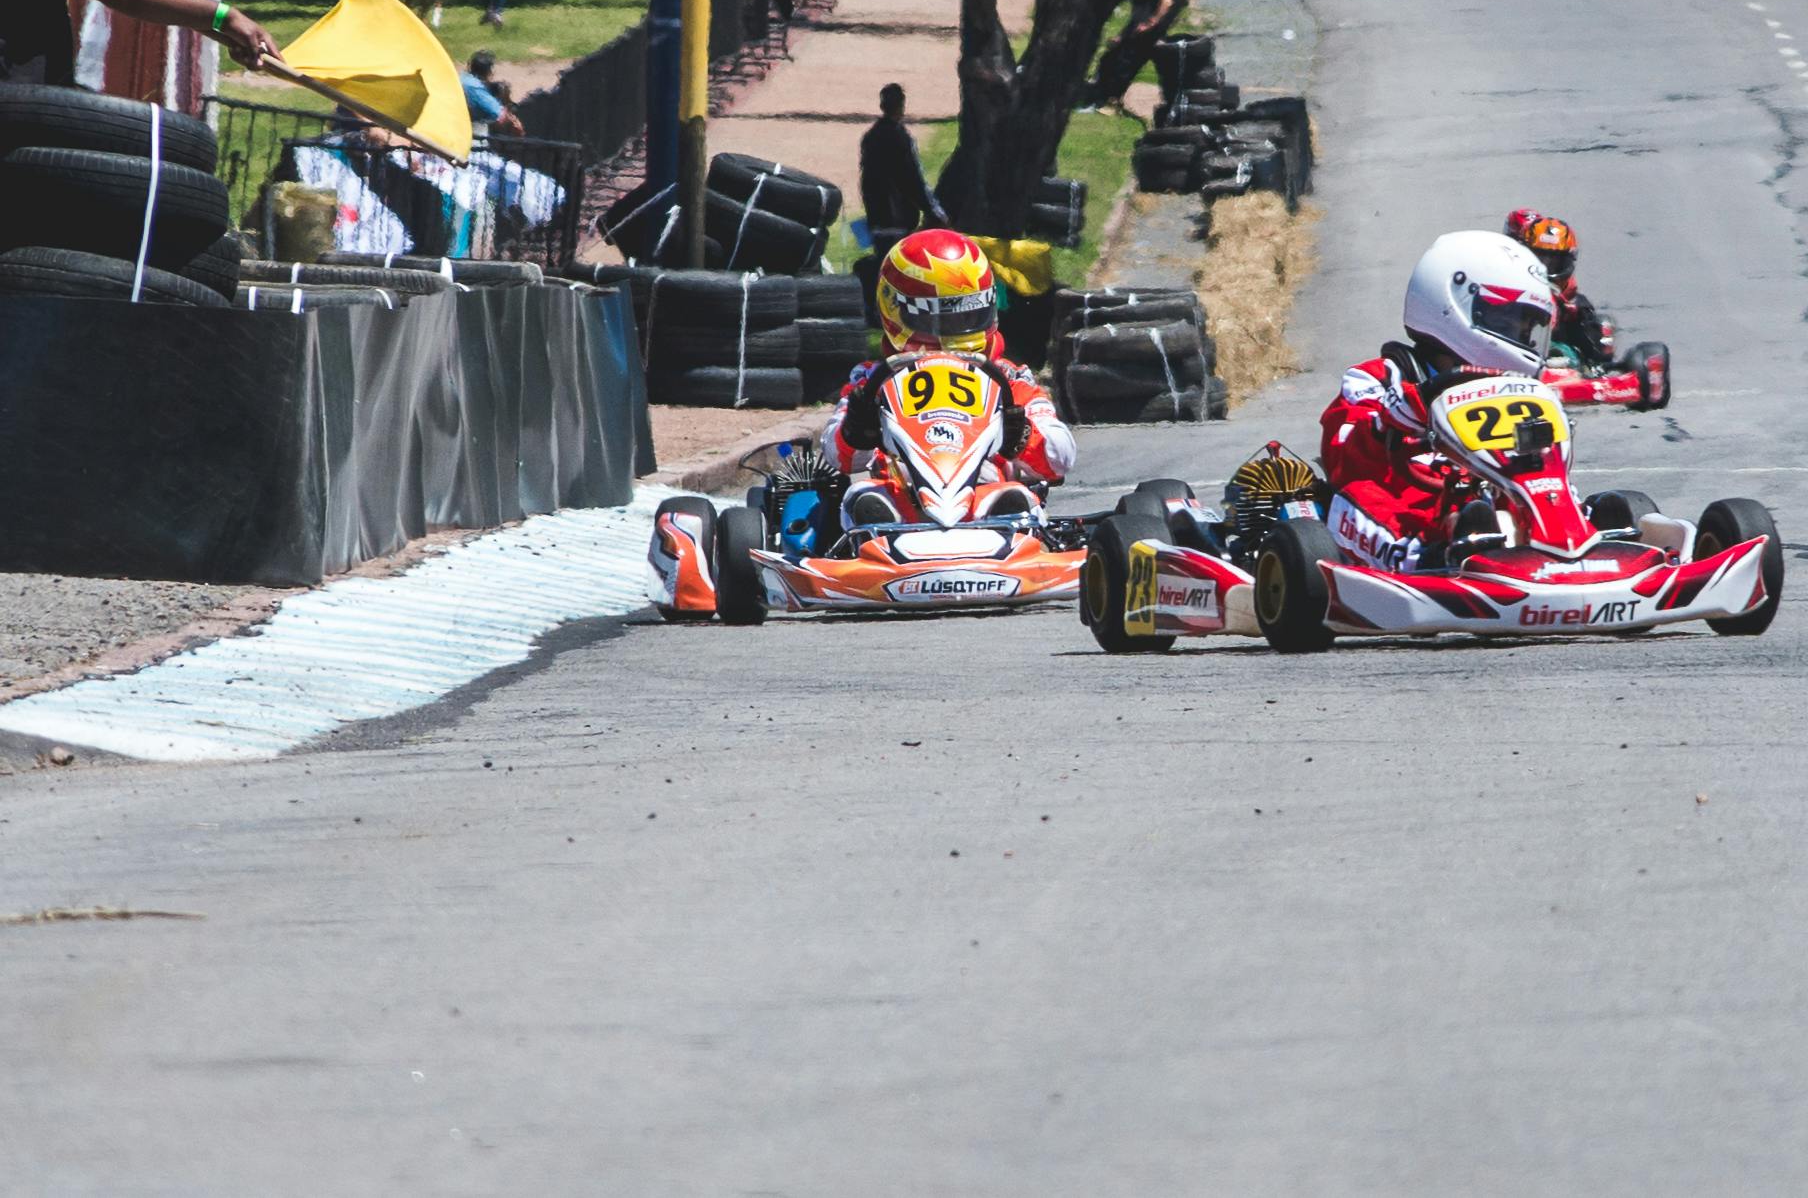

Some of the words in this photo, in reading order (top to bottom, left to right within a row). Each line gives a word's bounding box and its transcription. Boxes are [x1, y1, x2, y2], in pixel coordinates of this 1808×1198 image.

[908, 370, 976, 411] 95
[1447, 382, 1540, 406] birelART
[1158, 585, 1212, 609] birelART
[1519, 600, 1642, 627] birelART
